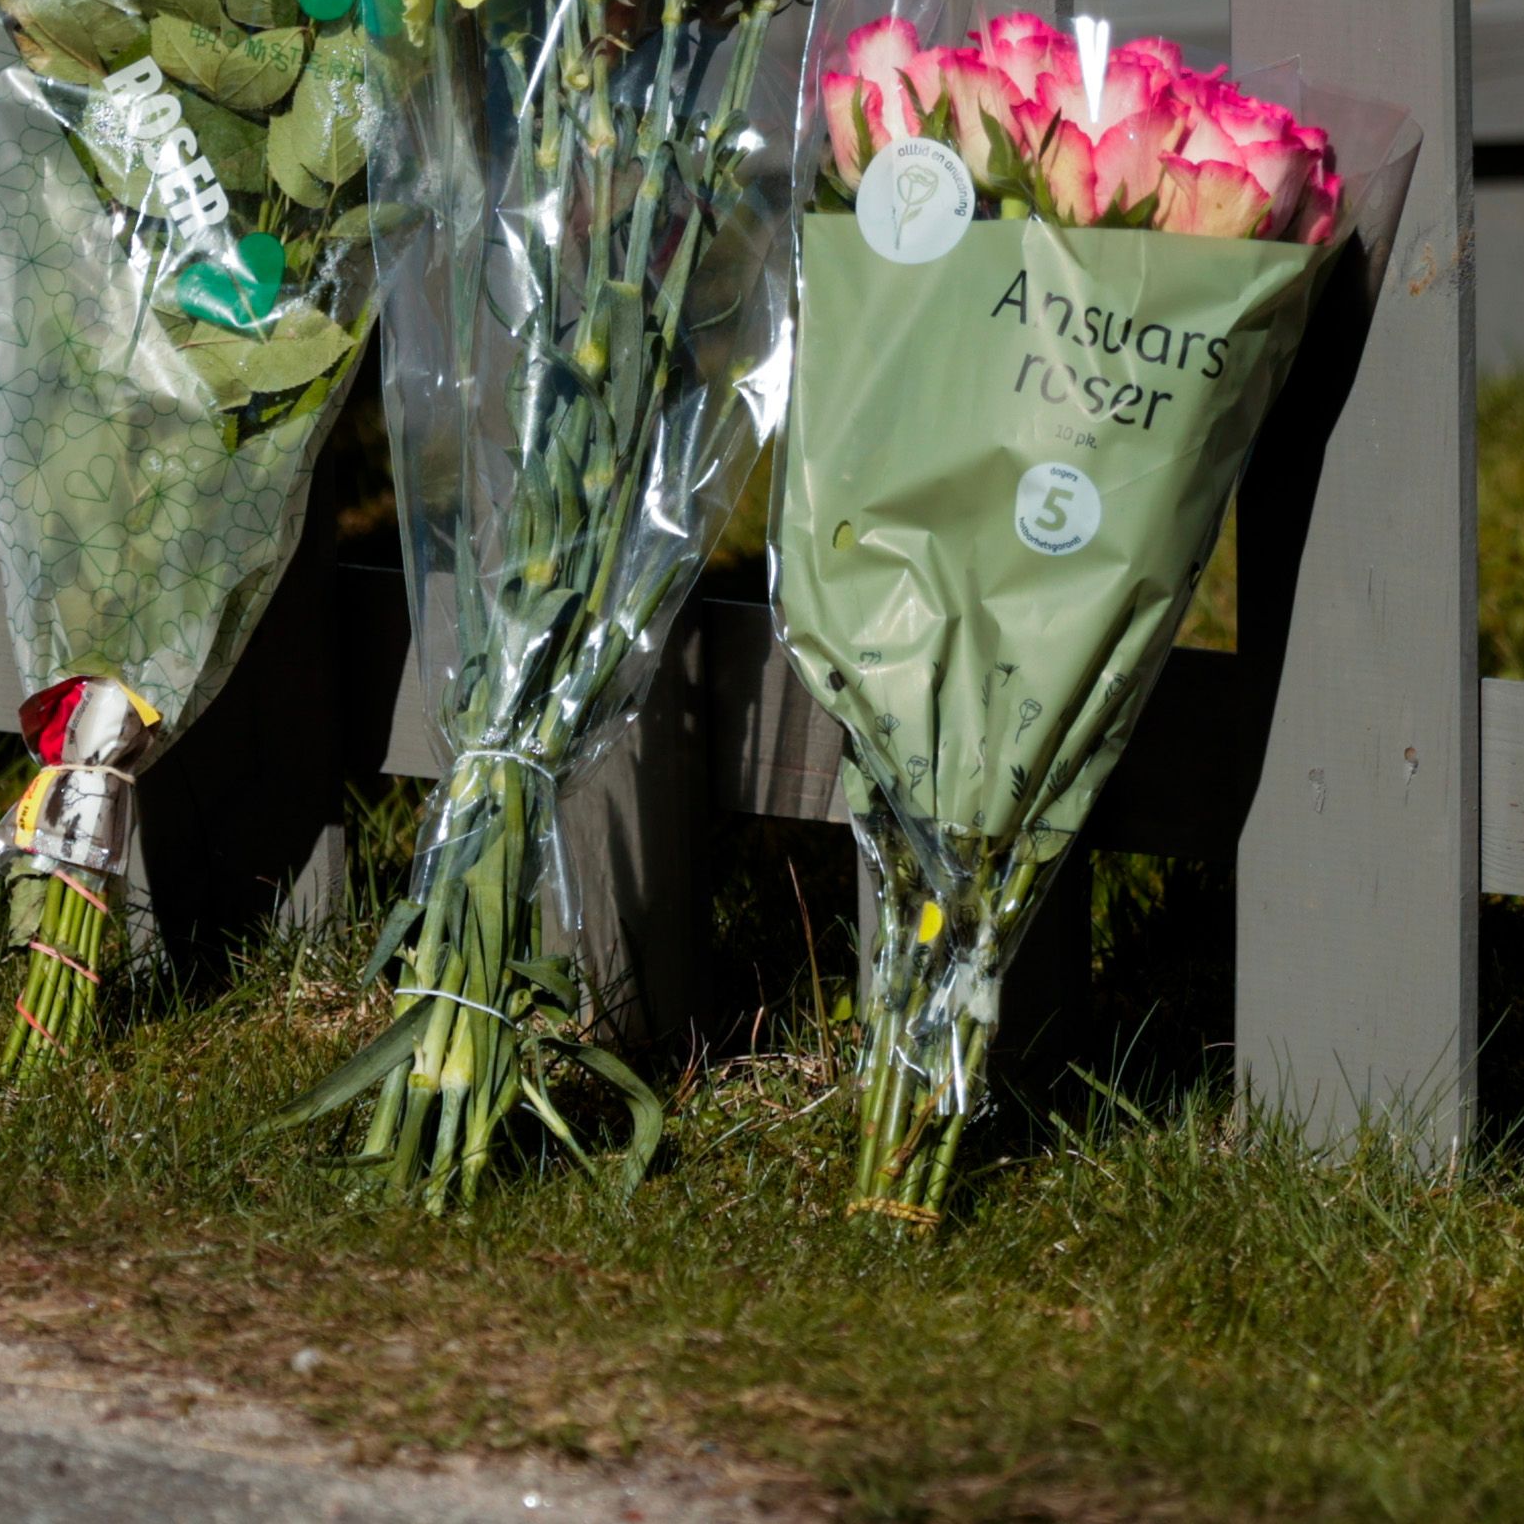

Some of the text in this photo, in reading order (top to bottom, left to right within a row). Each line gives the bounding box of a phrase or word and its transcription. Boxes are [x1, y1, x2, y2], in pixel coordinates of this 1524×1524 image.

[102, 55, 230, 240] ROSER
[990, 269, 1229, 380] Ansuars
[1013, 353, 1174, 430] roser
[1034, 486, 1076, 532] 5
